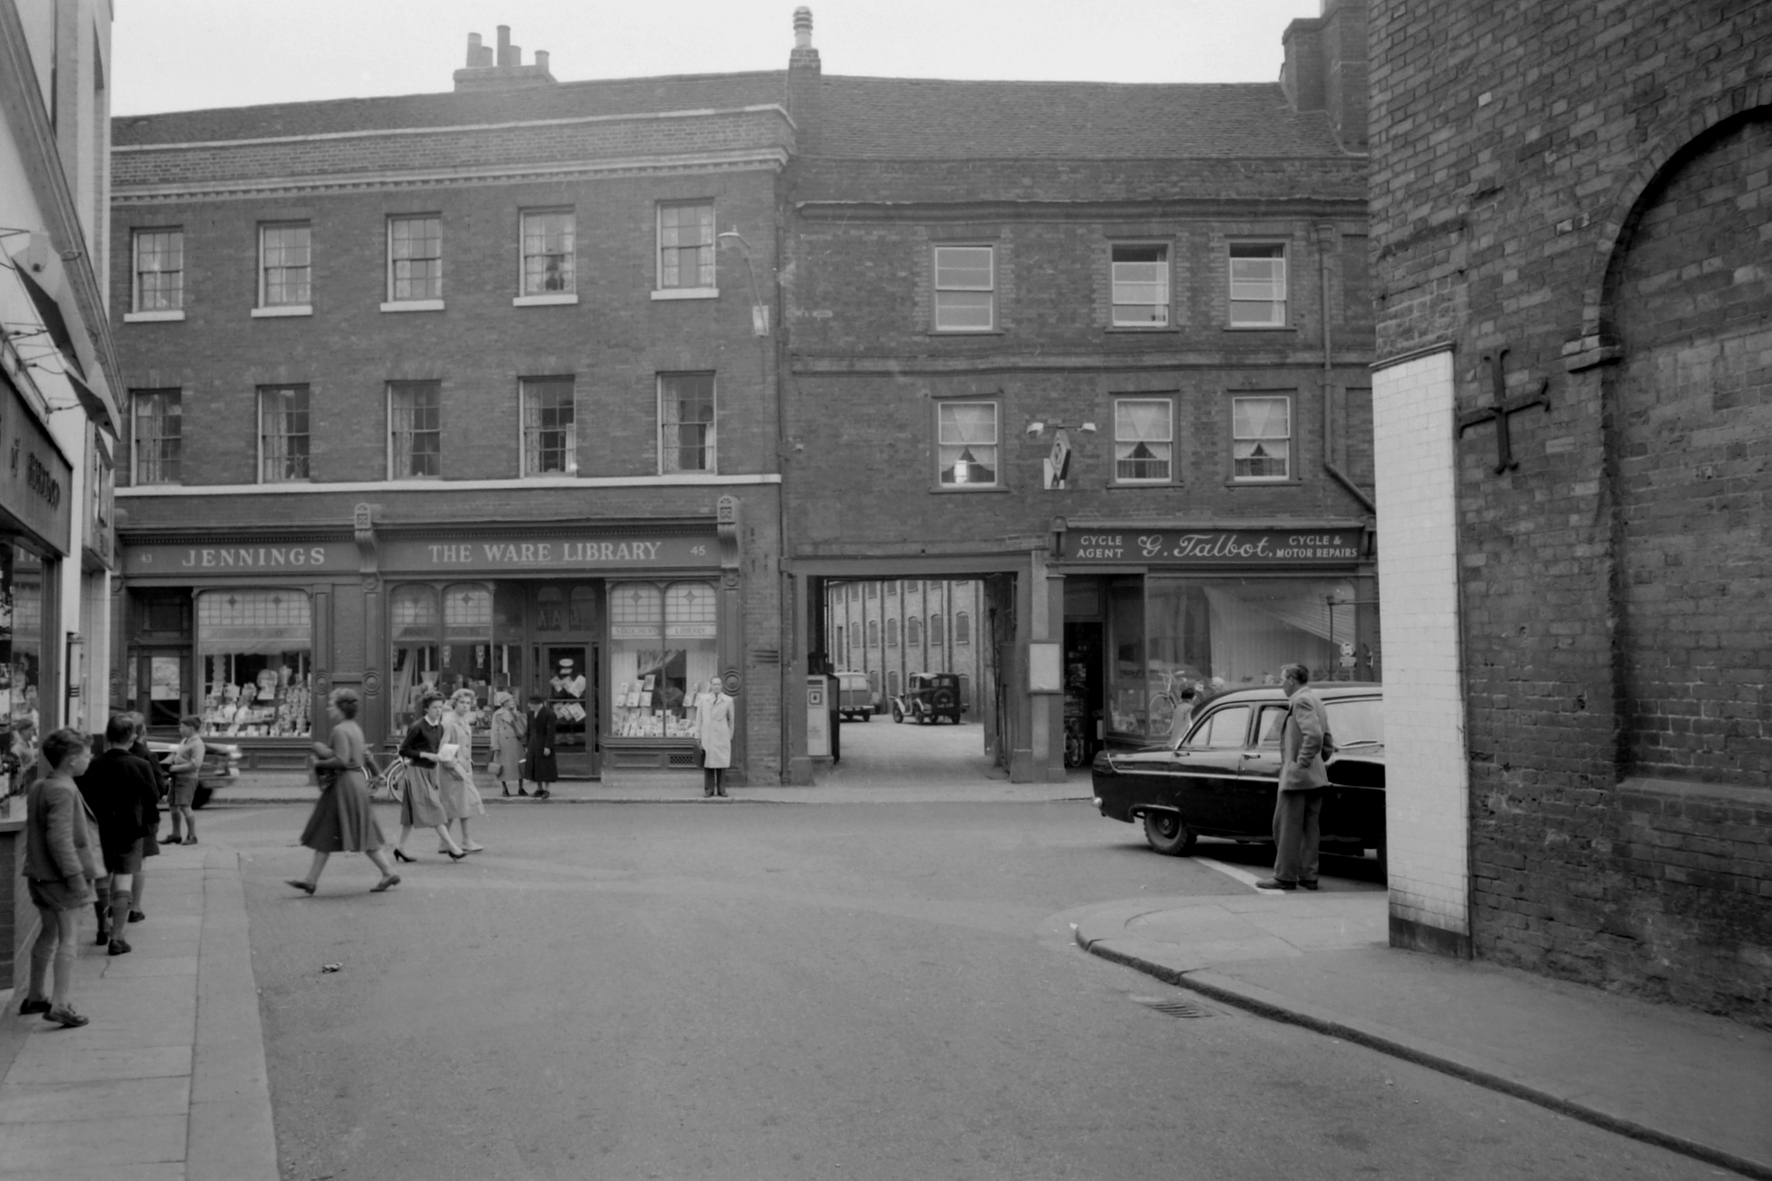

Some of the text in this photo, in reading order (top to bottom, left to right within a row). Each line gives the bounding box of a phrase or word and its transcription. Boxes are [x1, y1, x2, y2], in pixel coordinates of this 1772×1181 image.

[1080, 535, 1123, 545] CYCLE
[1138, 534, 1168, 557] G.
[1289, 535, 1342, 545] CYCLE &
[428, 541, 661, 562] THE WARE LIBRARY
[690, 545, 706, 556] 45
[1076, 548, 1124, 558] AGENT
[1276, 547, 1358, 558] MOTOR REPAIRS
[140, 553, 152, 564] 43
[182, 547, 325, 567] JENNINGS
